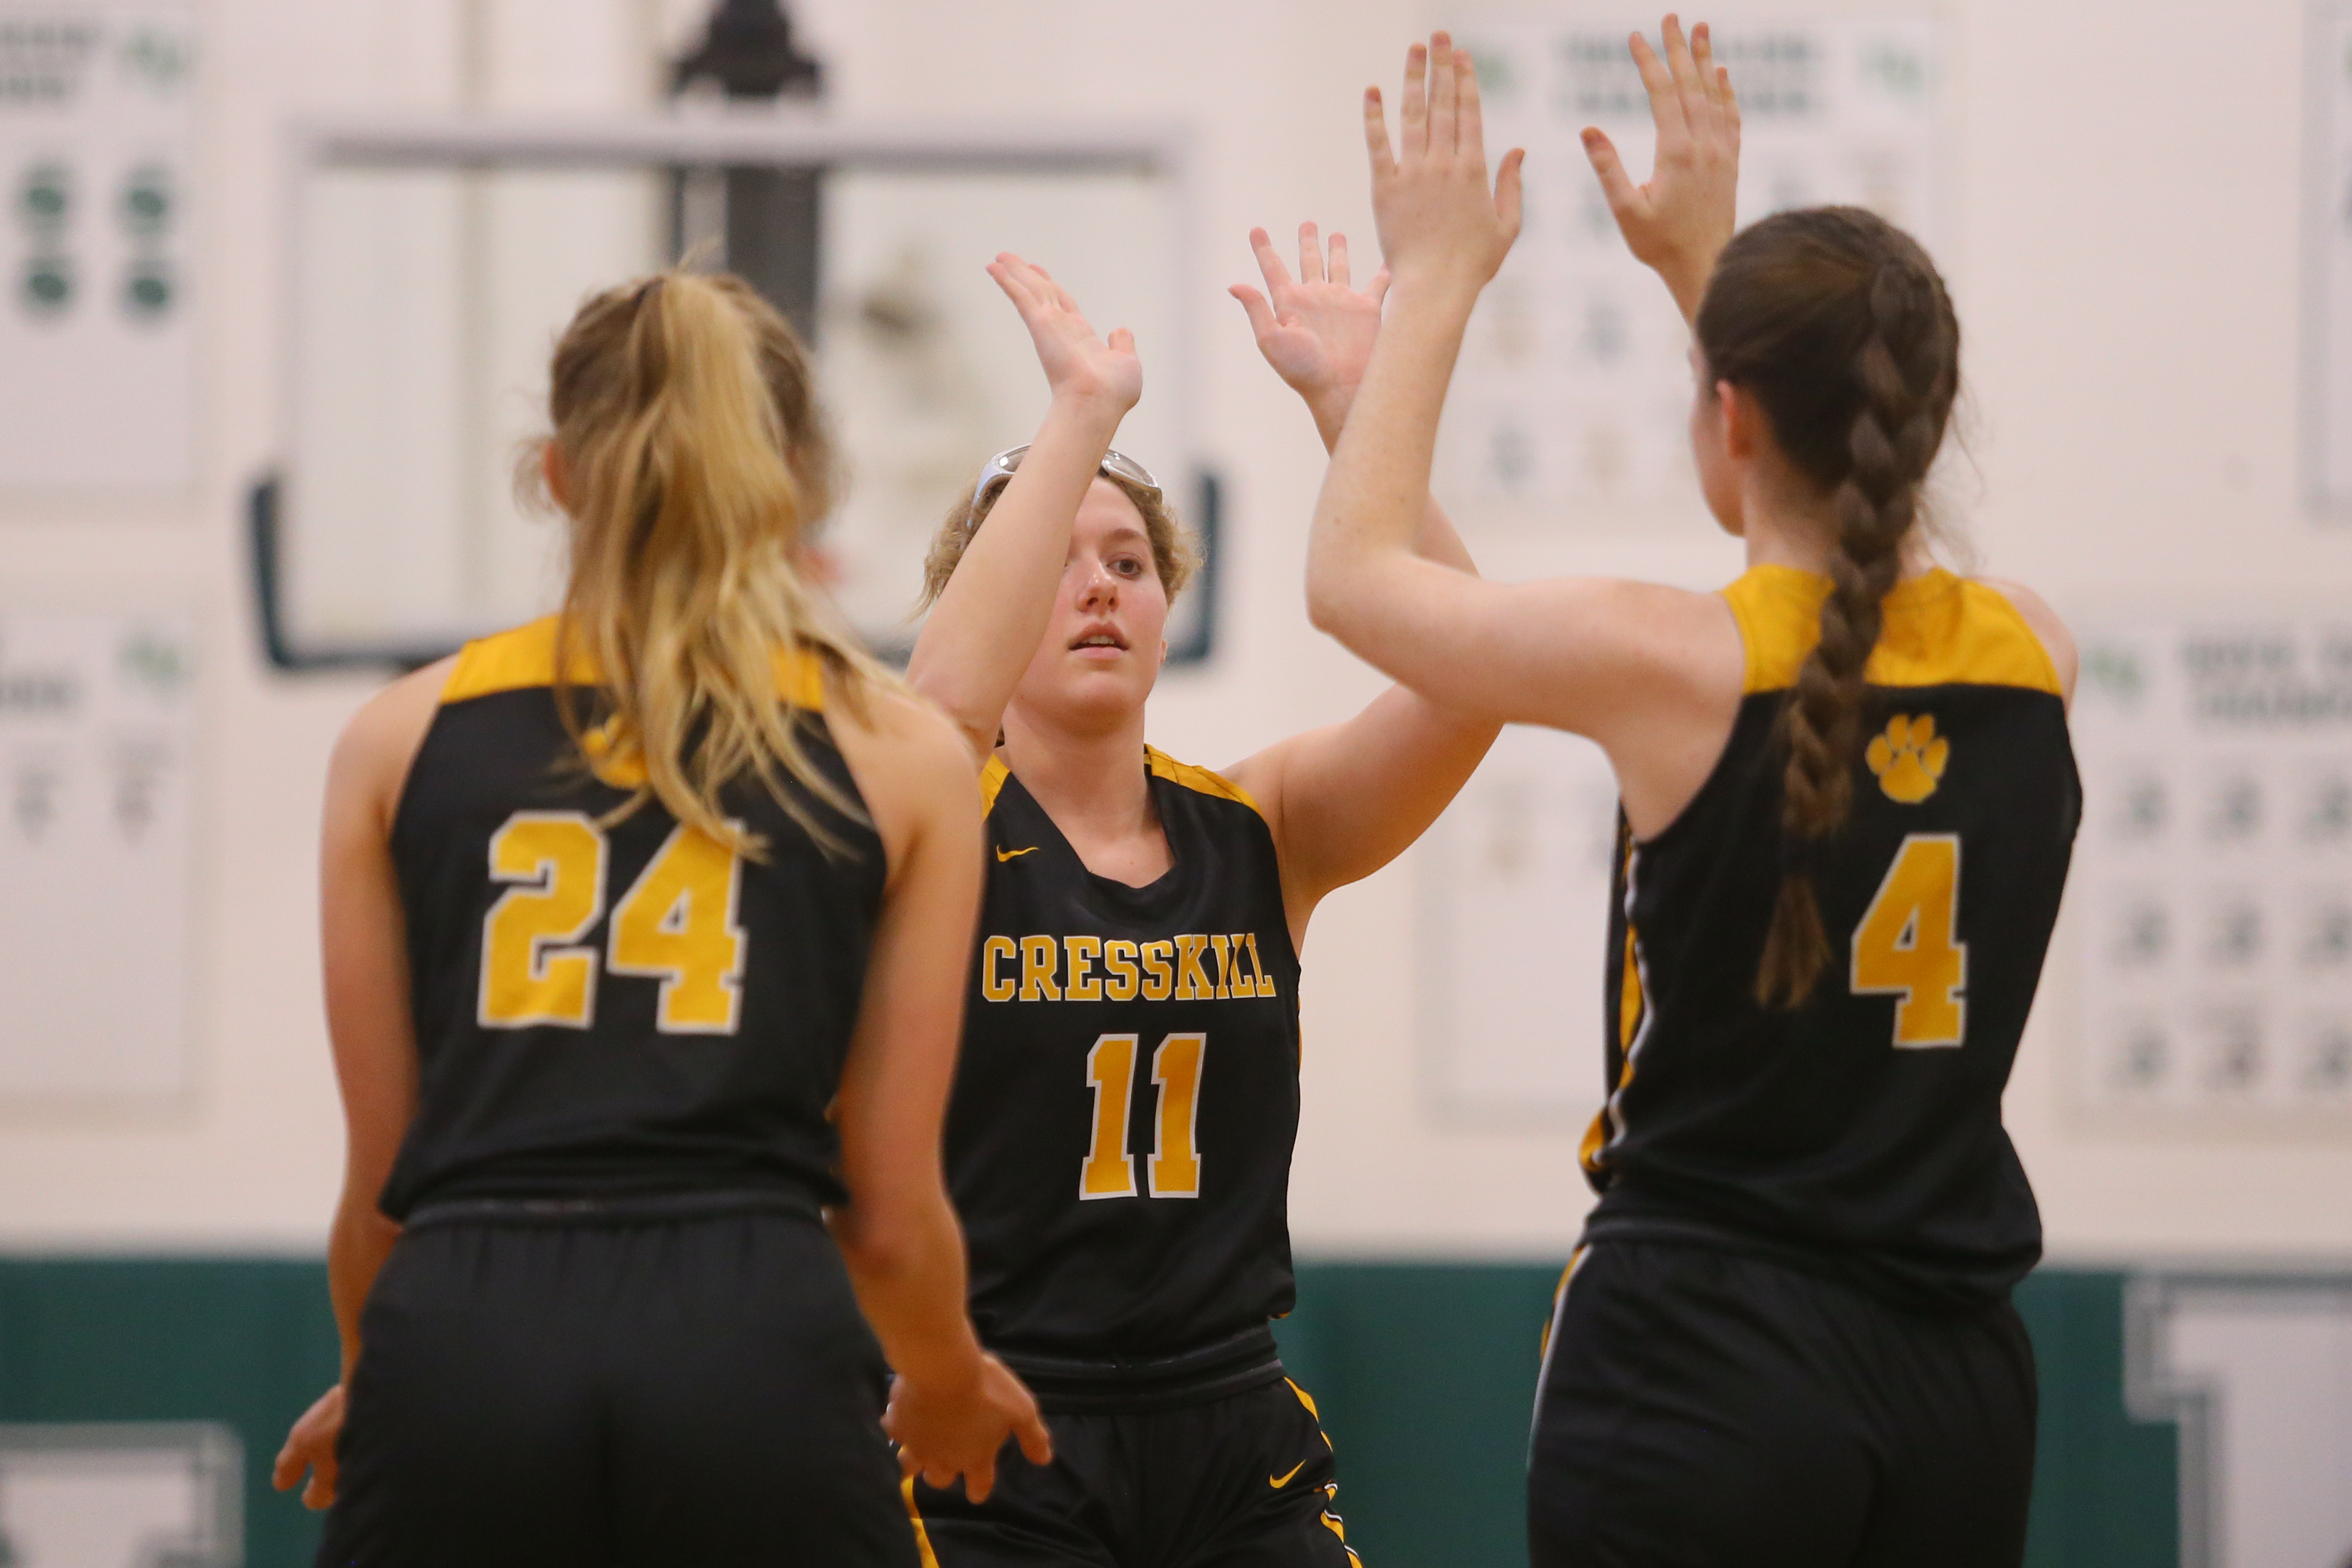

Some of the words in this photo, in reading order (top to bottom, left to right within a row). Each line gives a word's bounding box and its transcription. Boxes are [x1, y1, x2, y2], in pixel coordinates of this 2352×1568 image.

[478, 809, 748, 1035] 24
[982, 933, 1276, 1002] CRESSKILL
[1850, 832, 1968, 1048] 4
[1079, 1032, 1206, 1201] 11
